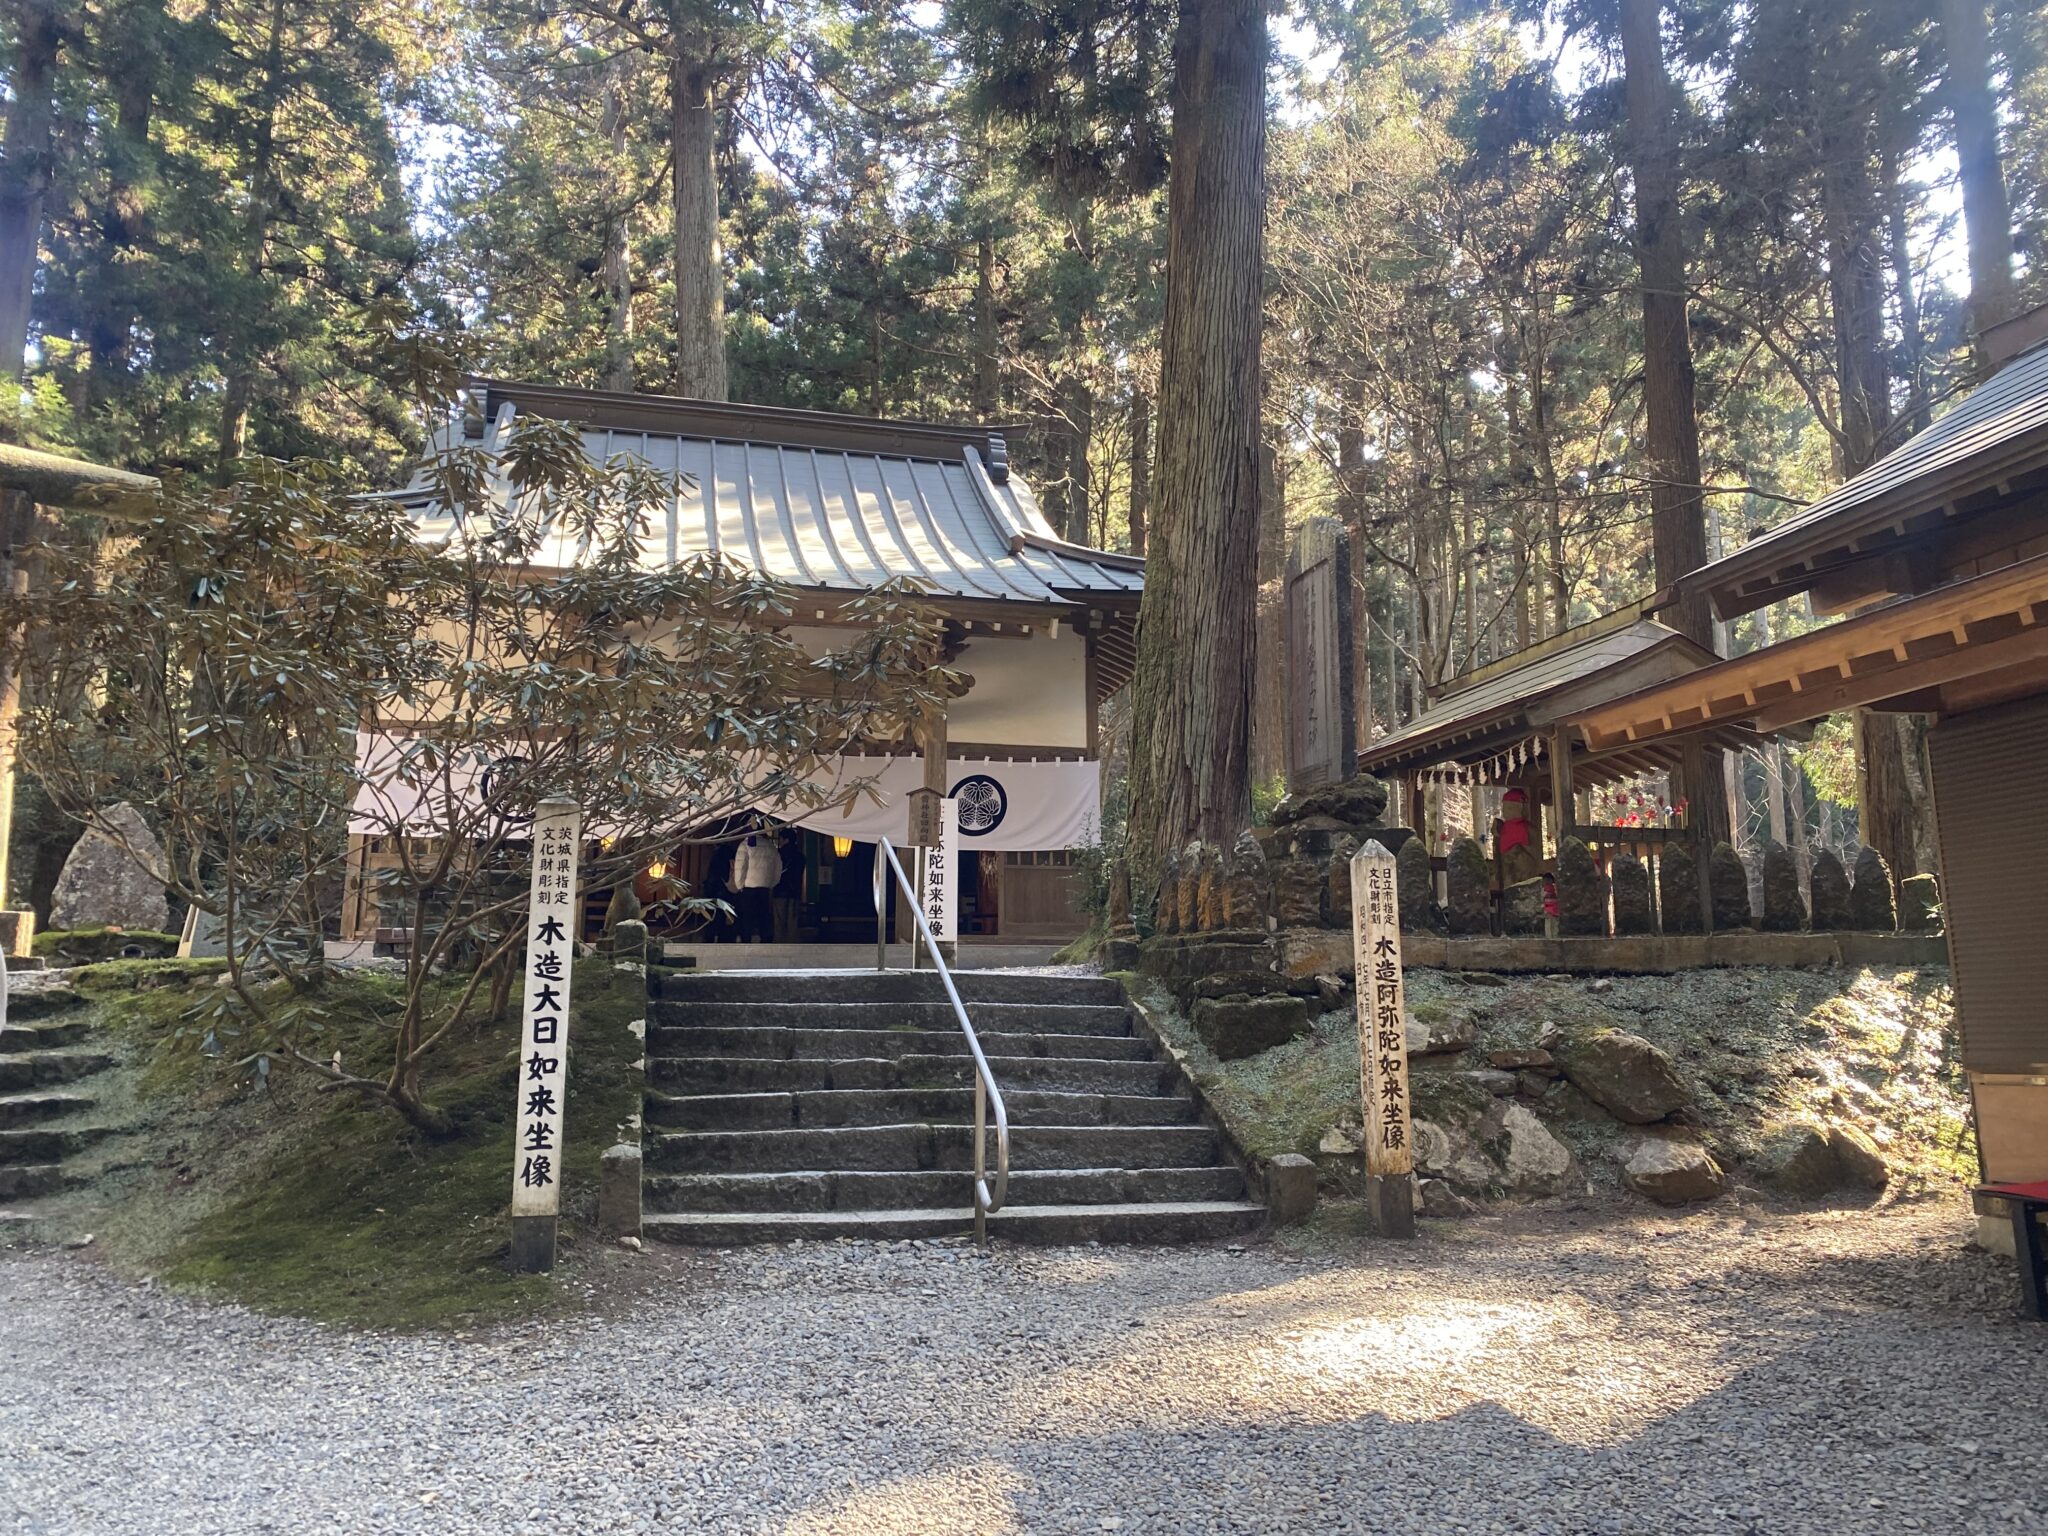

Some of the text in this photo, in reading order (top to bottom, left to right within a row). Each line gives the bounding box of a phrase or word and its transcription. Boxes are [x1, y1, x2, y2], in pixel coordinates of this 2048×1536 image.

[537, 827, 556, 905] 文化財彫刻
[554, 827, 573, 905] 茨城県指定
[928, 822, 945, 936] 弥陀如来坐像
[1368, 868, 1381, 925] 文化財彫刻
[1382, 868, 1395, 926] 日立市指定
[519, 915, 567, 1188] 木造大日如来坐像
[1373, 935, 1406, 1151] 木造阿弥陀如来坐像
